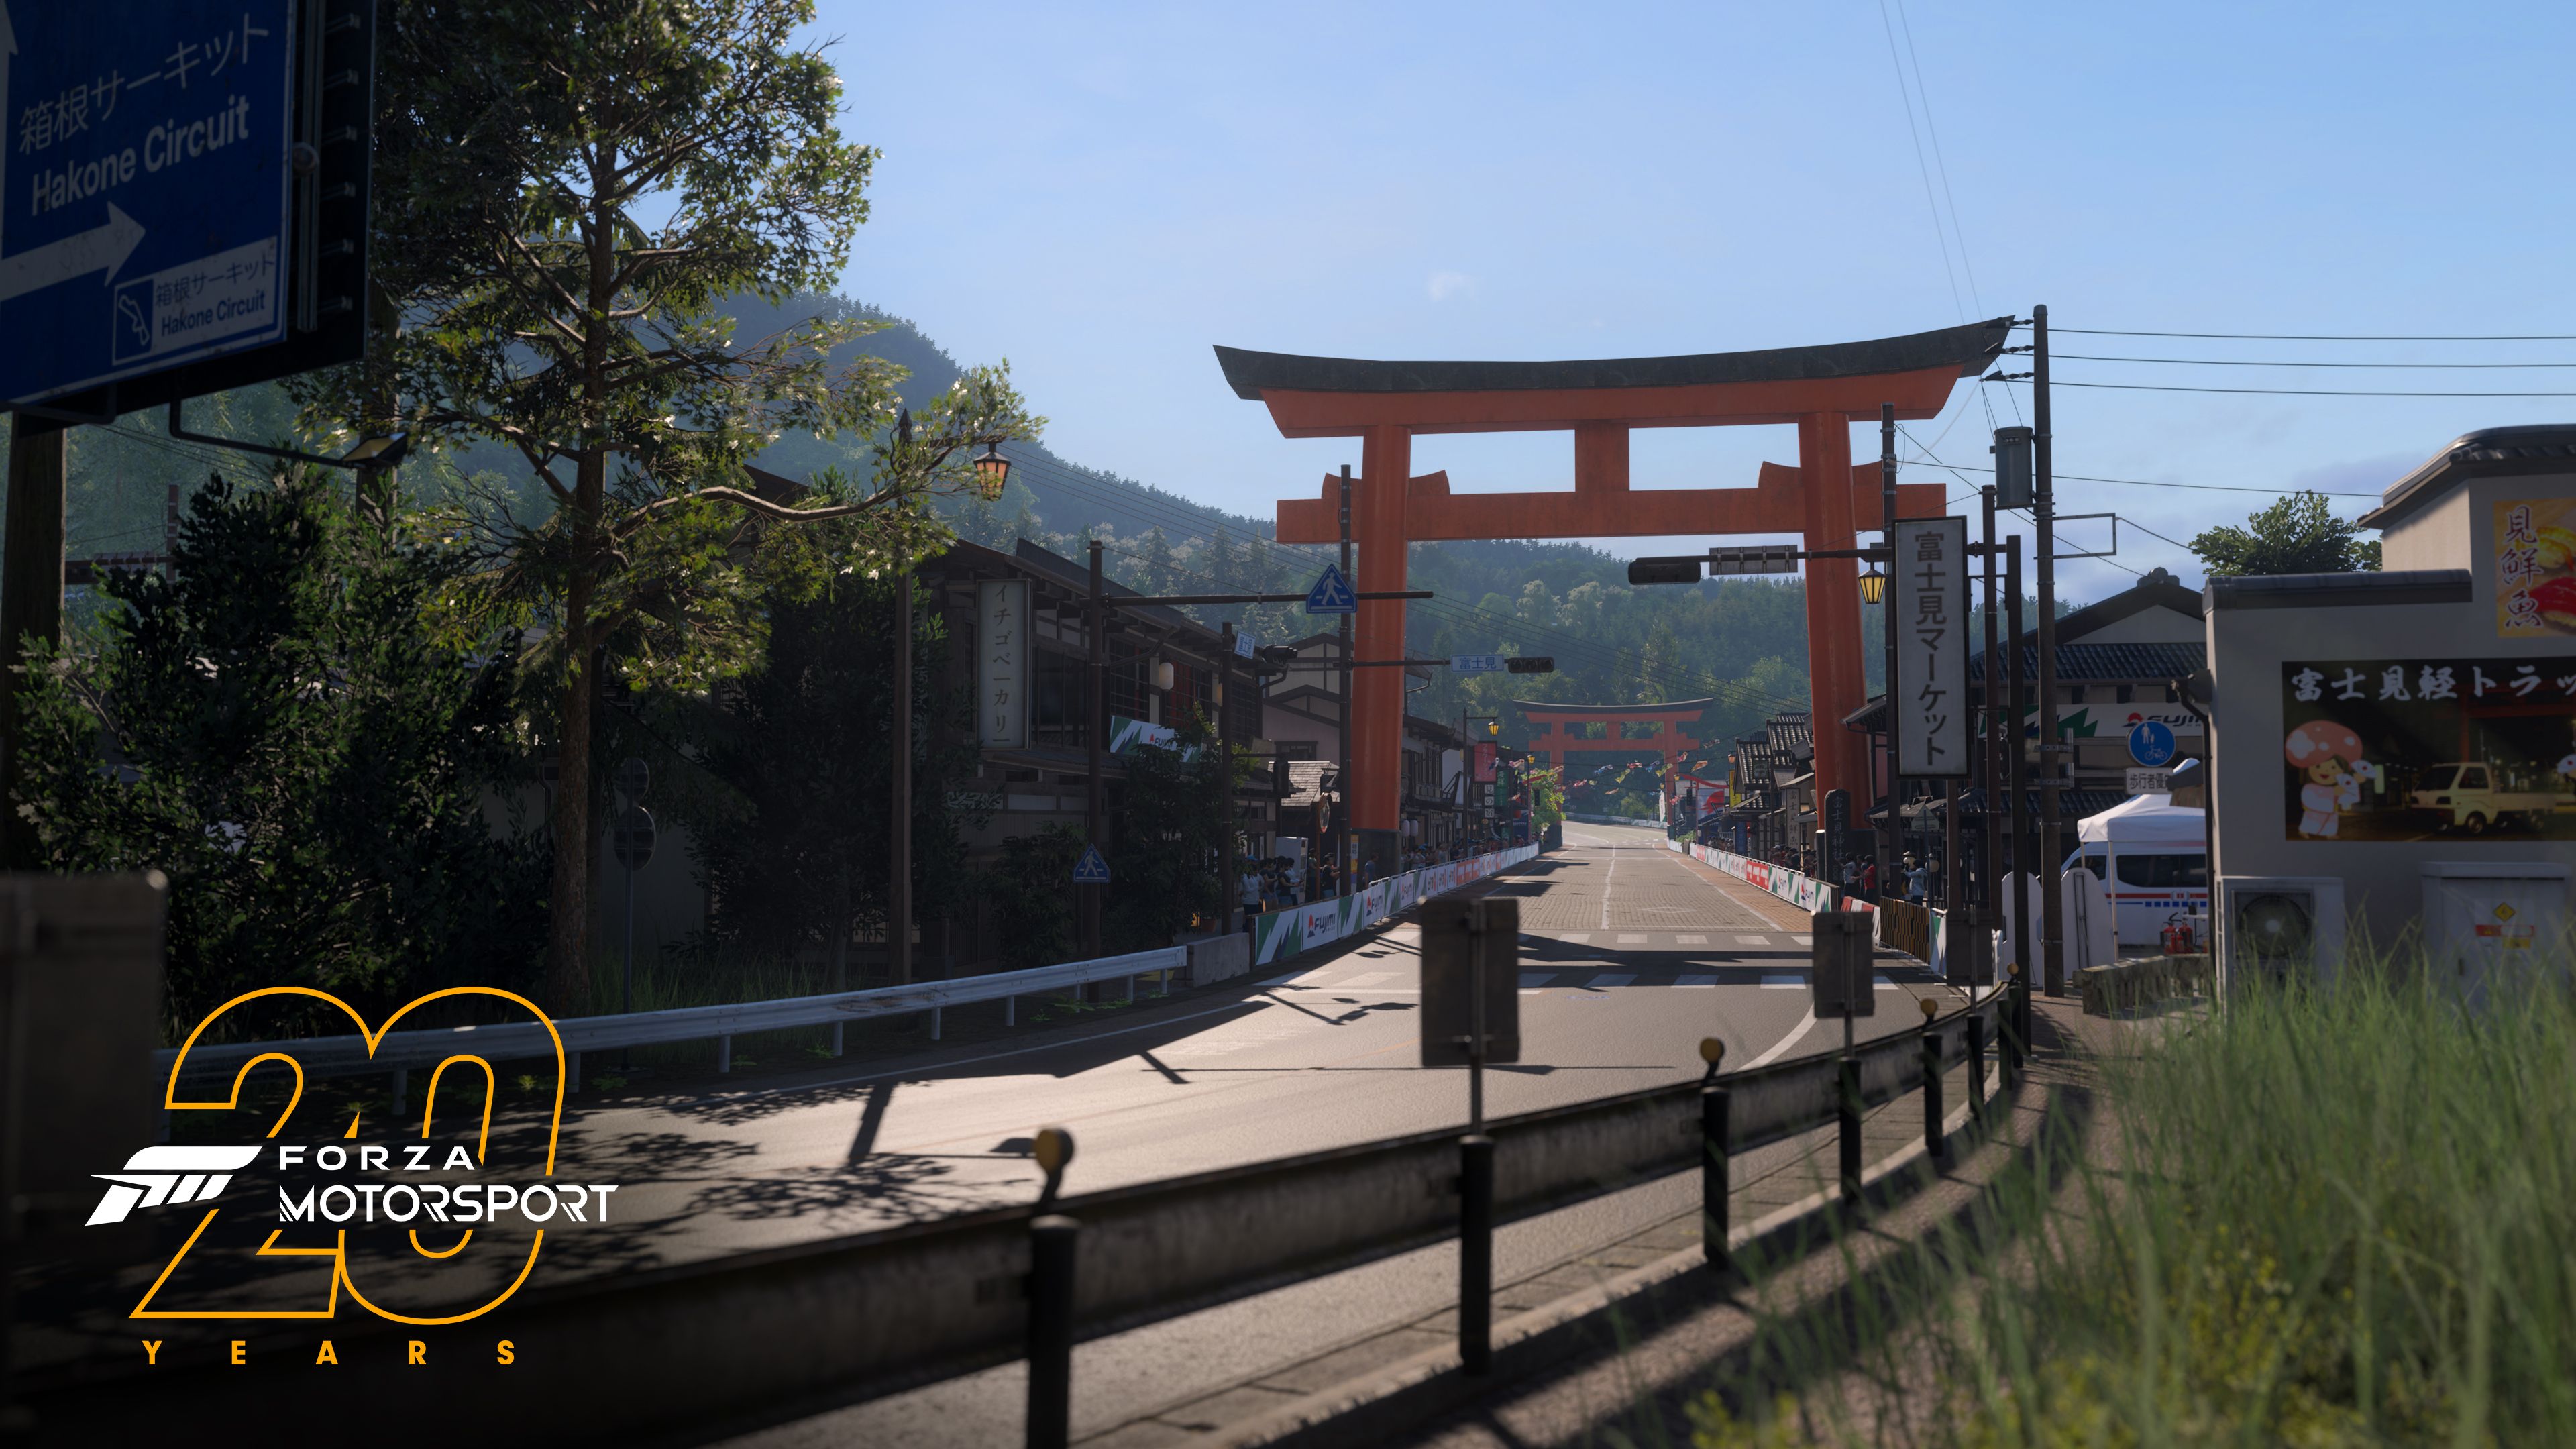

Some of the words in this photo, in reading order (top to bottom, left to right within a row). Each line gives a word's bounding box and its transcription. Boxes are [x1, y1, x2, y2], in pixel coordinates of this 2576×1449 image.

[19, 13, 269, 155] 箱根サーキット
[32, 152, 135, 216] Hakone
[144, 95, 249, 172] Circuit
[155, 253, 274, 308] 箱根サーキット
[162, 307, 213, 337] Hakone
[217, 290, 265, 320] Circuit
[2500, 504, 2544, 627] 見鮮魚
[993, 584, 1012, 742] イチゴベーカリー
[1460, 657, 1496, 669] 富士見
[1915, 531, 1947, 766] 富士見マーケット
[2130, 773, 2169, 789] 歩行者優
